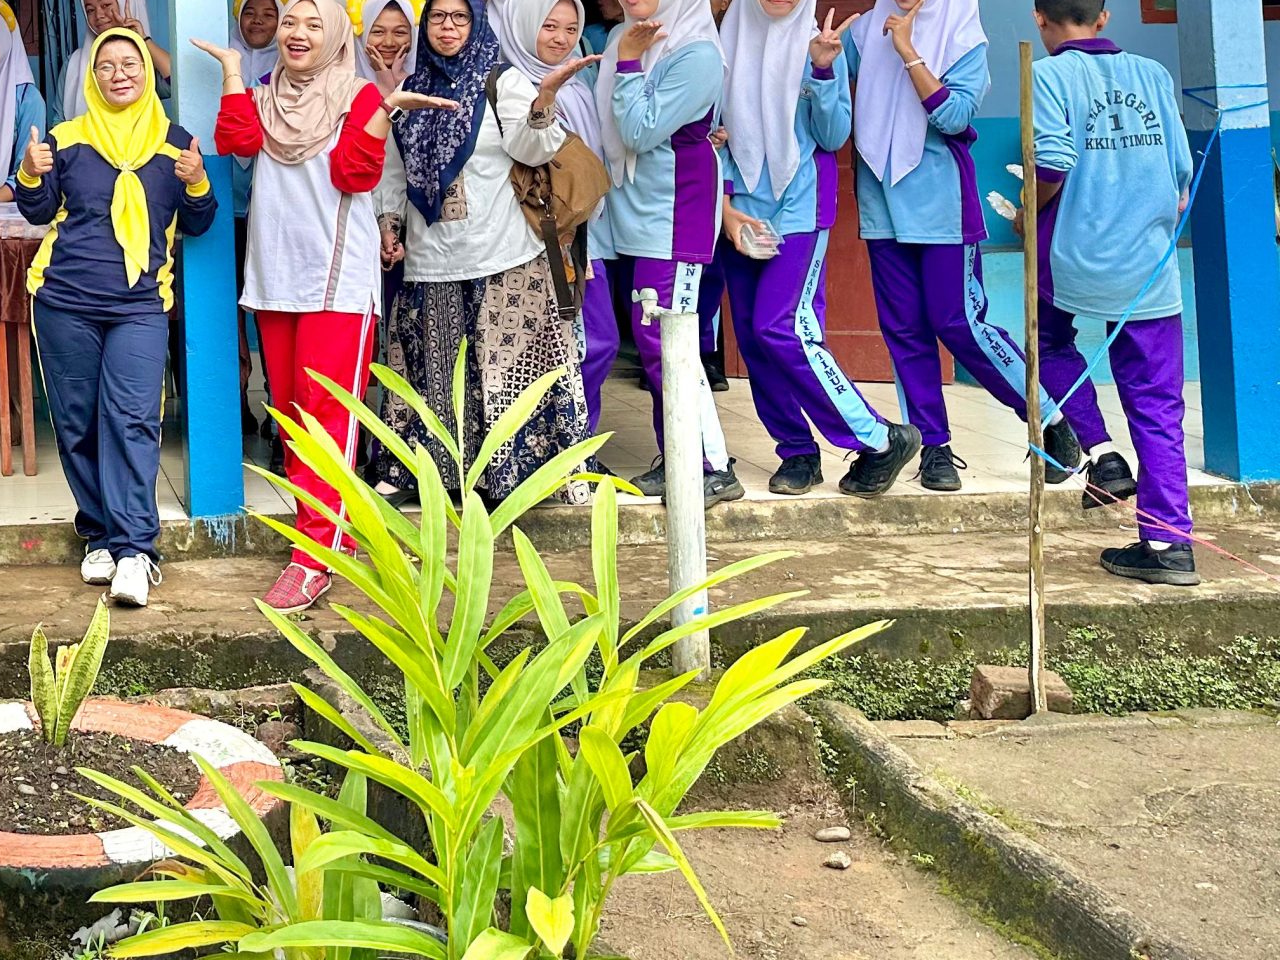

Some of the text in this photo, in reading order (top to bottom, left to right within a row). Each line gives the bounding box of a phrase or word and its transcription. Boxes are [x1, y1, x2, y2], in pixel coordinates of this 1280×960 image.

[1108, 113, 1124, 132] 1
[1120, 133, 1164, 149] TIMUR
[981, 327, 1015, 368] TIMUR
[814, 351, 848, 395] TIMUR
